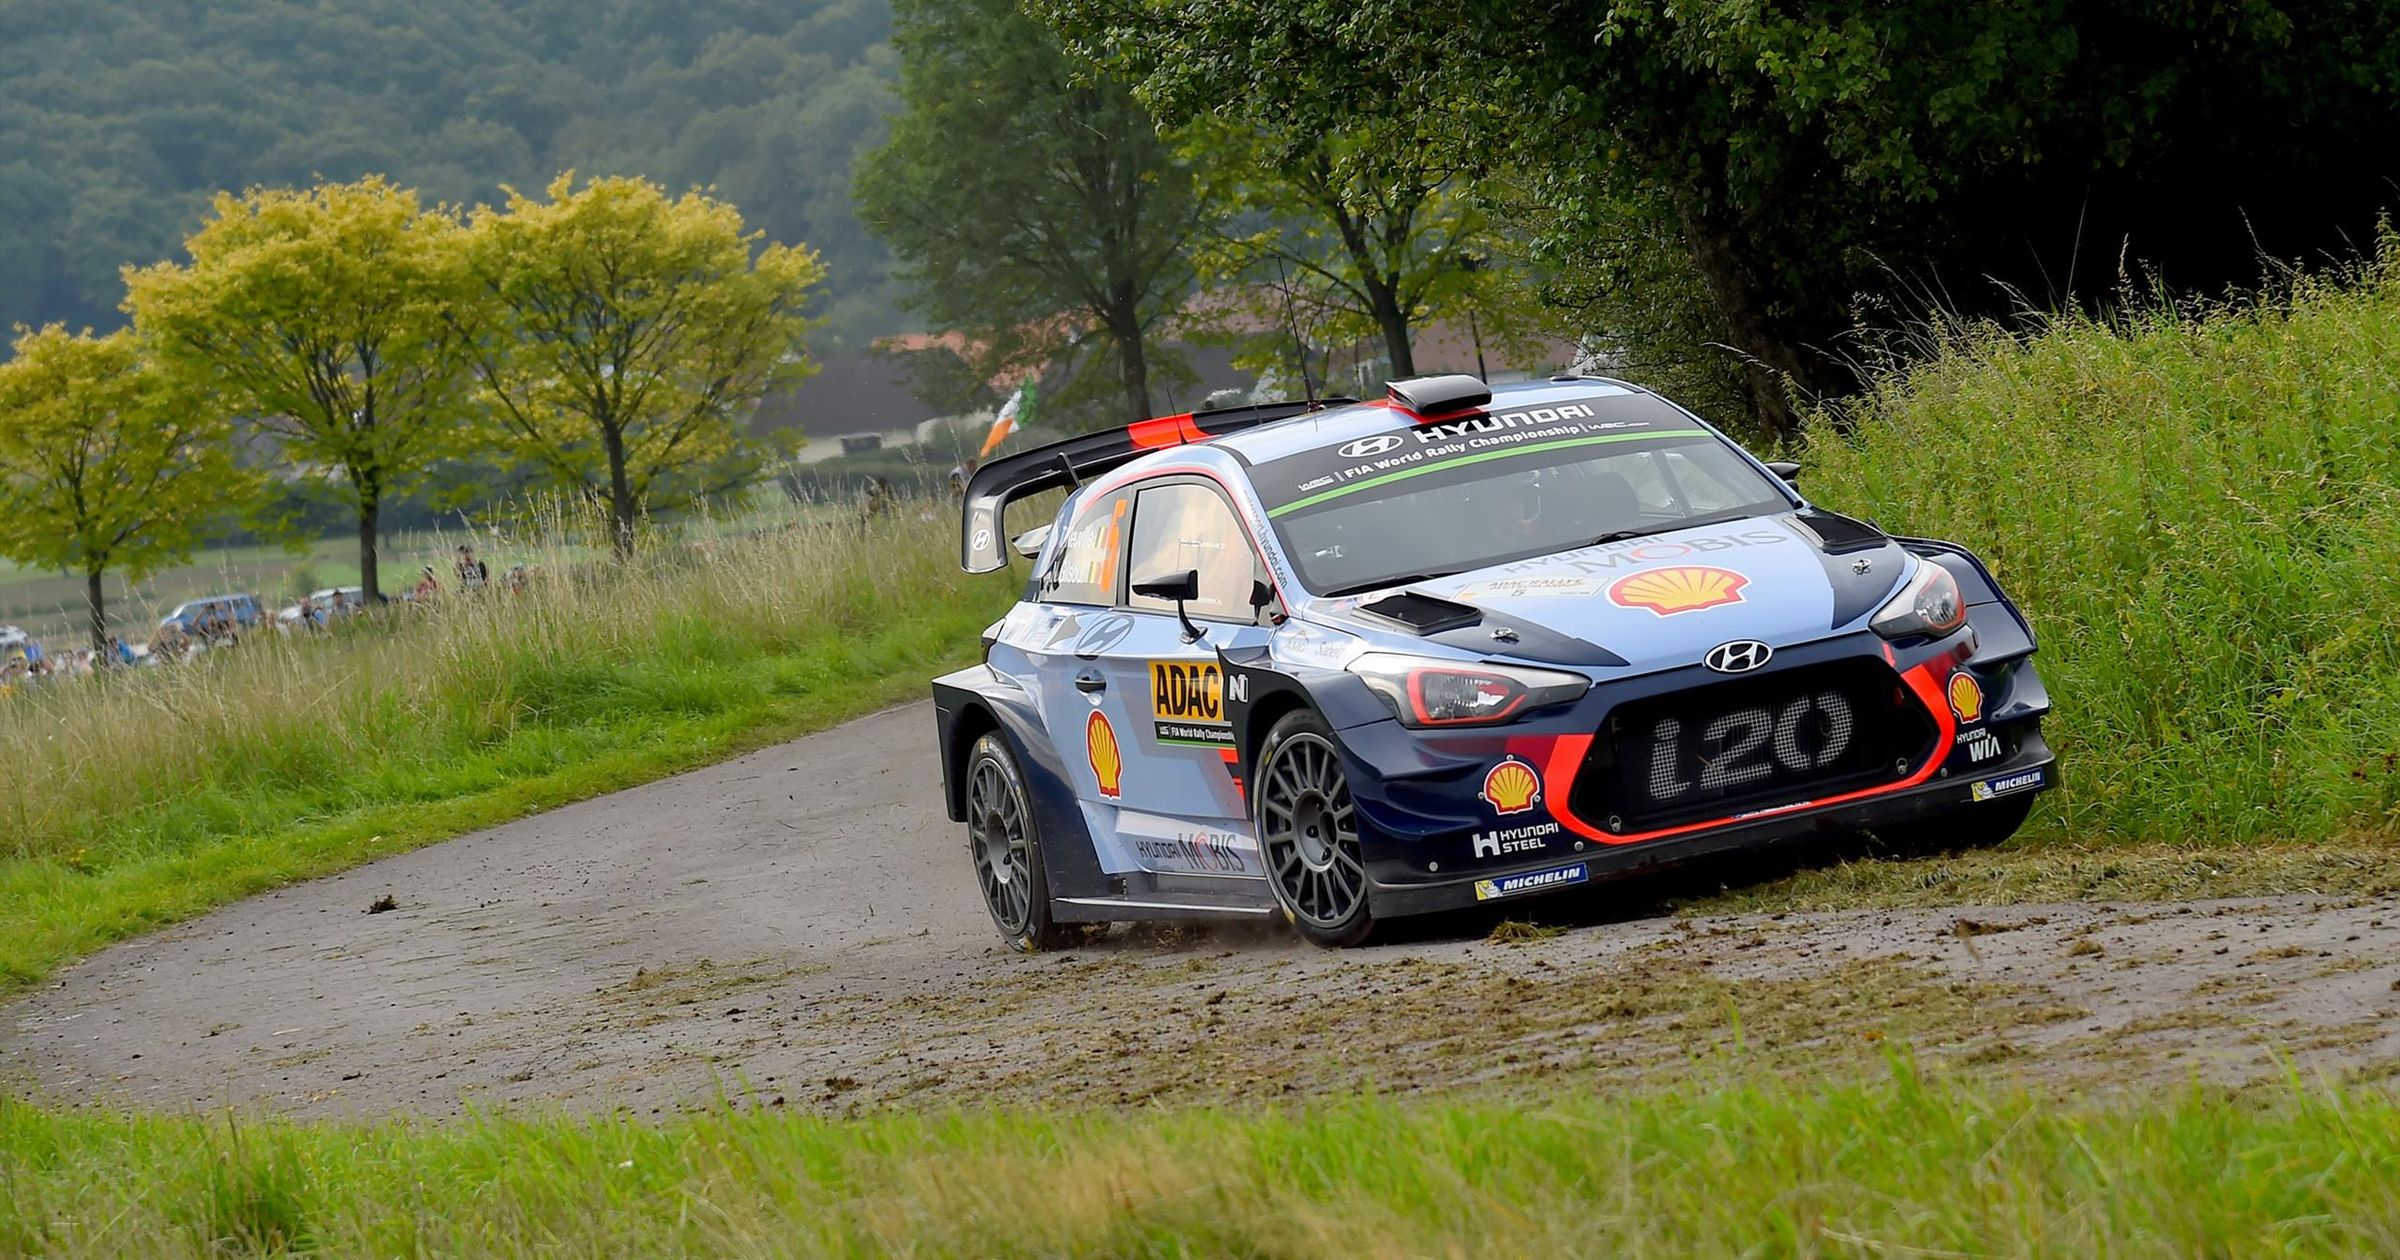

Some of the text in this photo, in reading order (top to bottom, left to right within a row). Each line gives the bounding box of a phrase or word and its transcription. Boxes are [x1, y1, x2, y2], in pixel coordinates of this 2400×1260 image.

[1412, 404, 1595, 444] HYUNDAI
[1345, 465, 1374, 479] FIA
[1374, 451, 1423, 470] World
[1427, 439, 1467, 458] Rally
[1470, 423, 1581, 449] Championship
[1504, 536, 1667, 574] HYUNDAI
[1567, 530, 1789, 575] MOBIS
[1155, 664, 1220, 719] ADAC
[1649, 690, 1854, 800] i20
[1956, 727, 1987, 745] HYUNDAI
[1969, 733, 2002, 763] WIA
[1995, 771, 2041, 792] MICHELIN
[1500, 822, 1560, 841] HYUNDAI
[1502, 837, 1547, 853] STEEL
[1135, 830, 1246, 873] HYUNDAI MOBIS
[1503, 867, 1581, 891] MICHELIN
